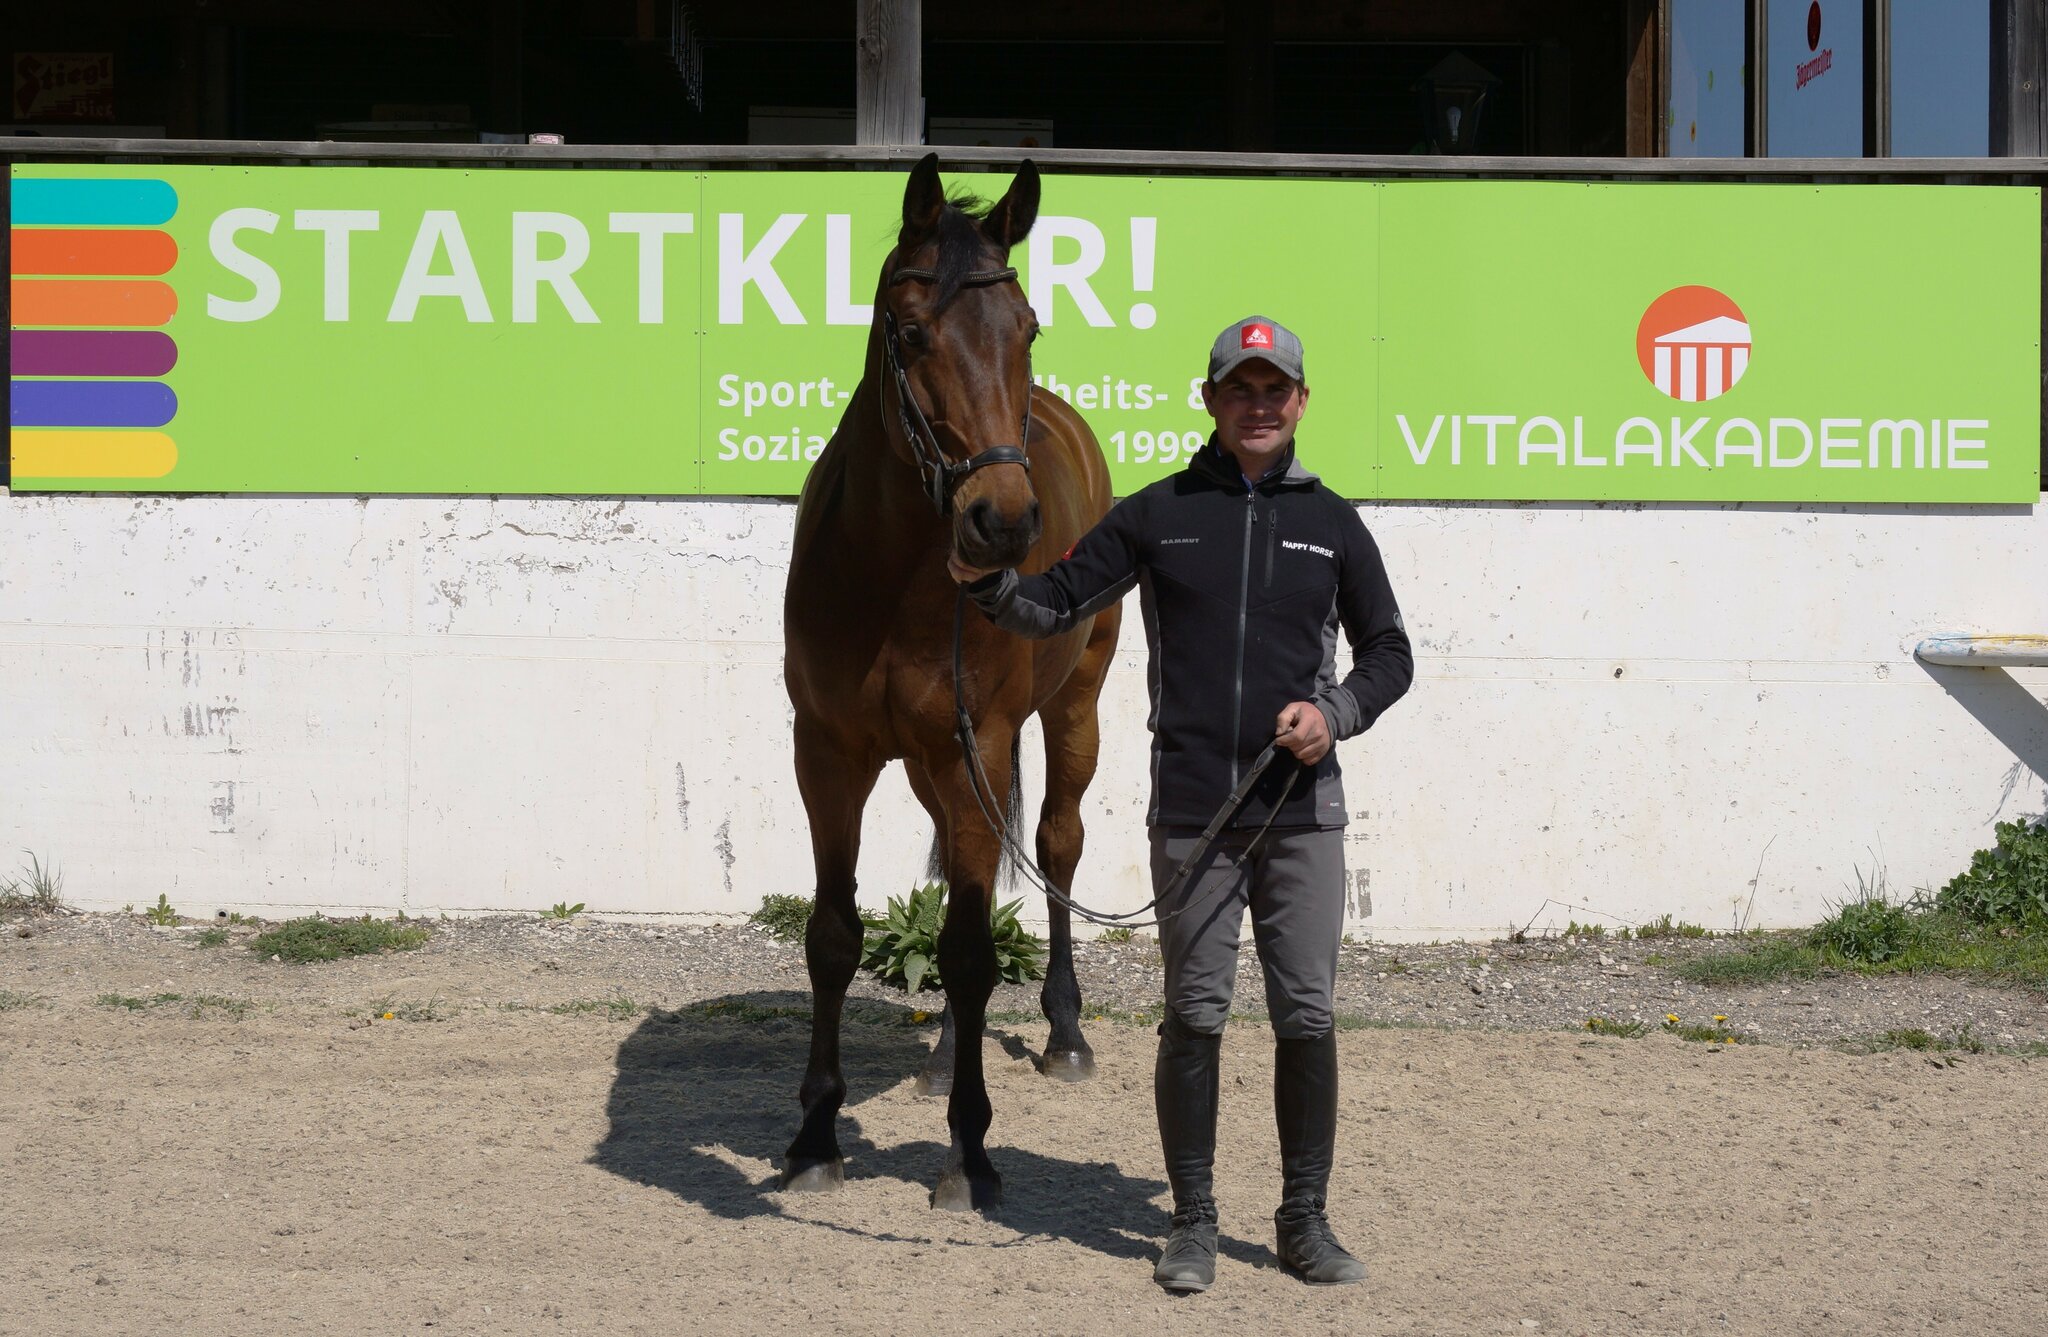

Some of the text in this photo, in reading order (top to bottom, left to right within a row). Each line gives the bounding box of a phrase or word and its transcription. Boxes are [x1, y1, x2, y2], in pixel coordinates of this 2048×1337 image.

[16, 55, 109, 116] Stiegl
[207, 207, 1158, 330] STARTKLR!
[718, 374, 1208, 417] Sport- heits- &
[718, 427, 1205, 464] Sozia 1999
[1396, 414, 1989, 469] VITALAKADEMIE
[1282, 540, 1335, 558] HAPPY HORSE
